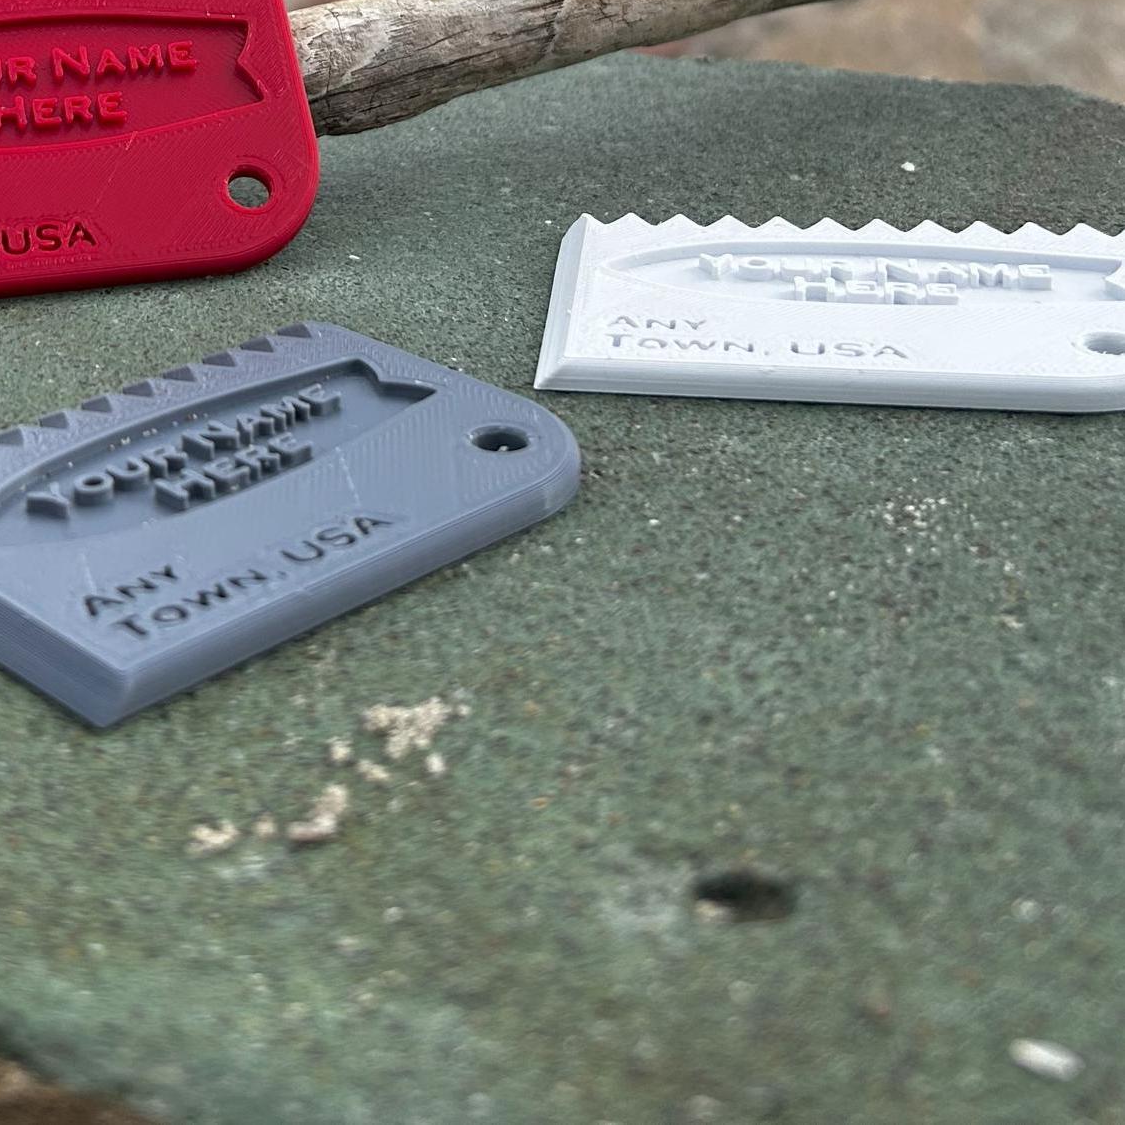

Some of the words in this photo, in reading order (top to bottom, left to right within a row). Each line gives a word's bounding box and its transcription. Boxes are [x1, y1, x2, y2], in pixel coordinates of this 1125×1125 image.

[0, 220, 97, 256] USA
[790, 341, 909, 360] USA
[279, 514, 396, 564] USA
